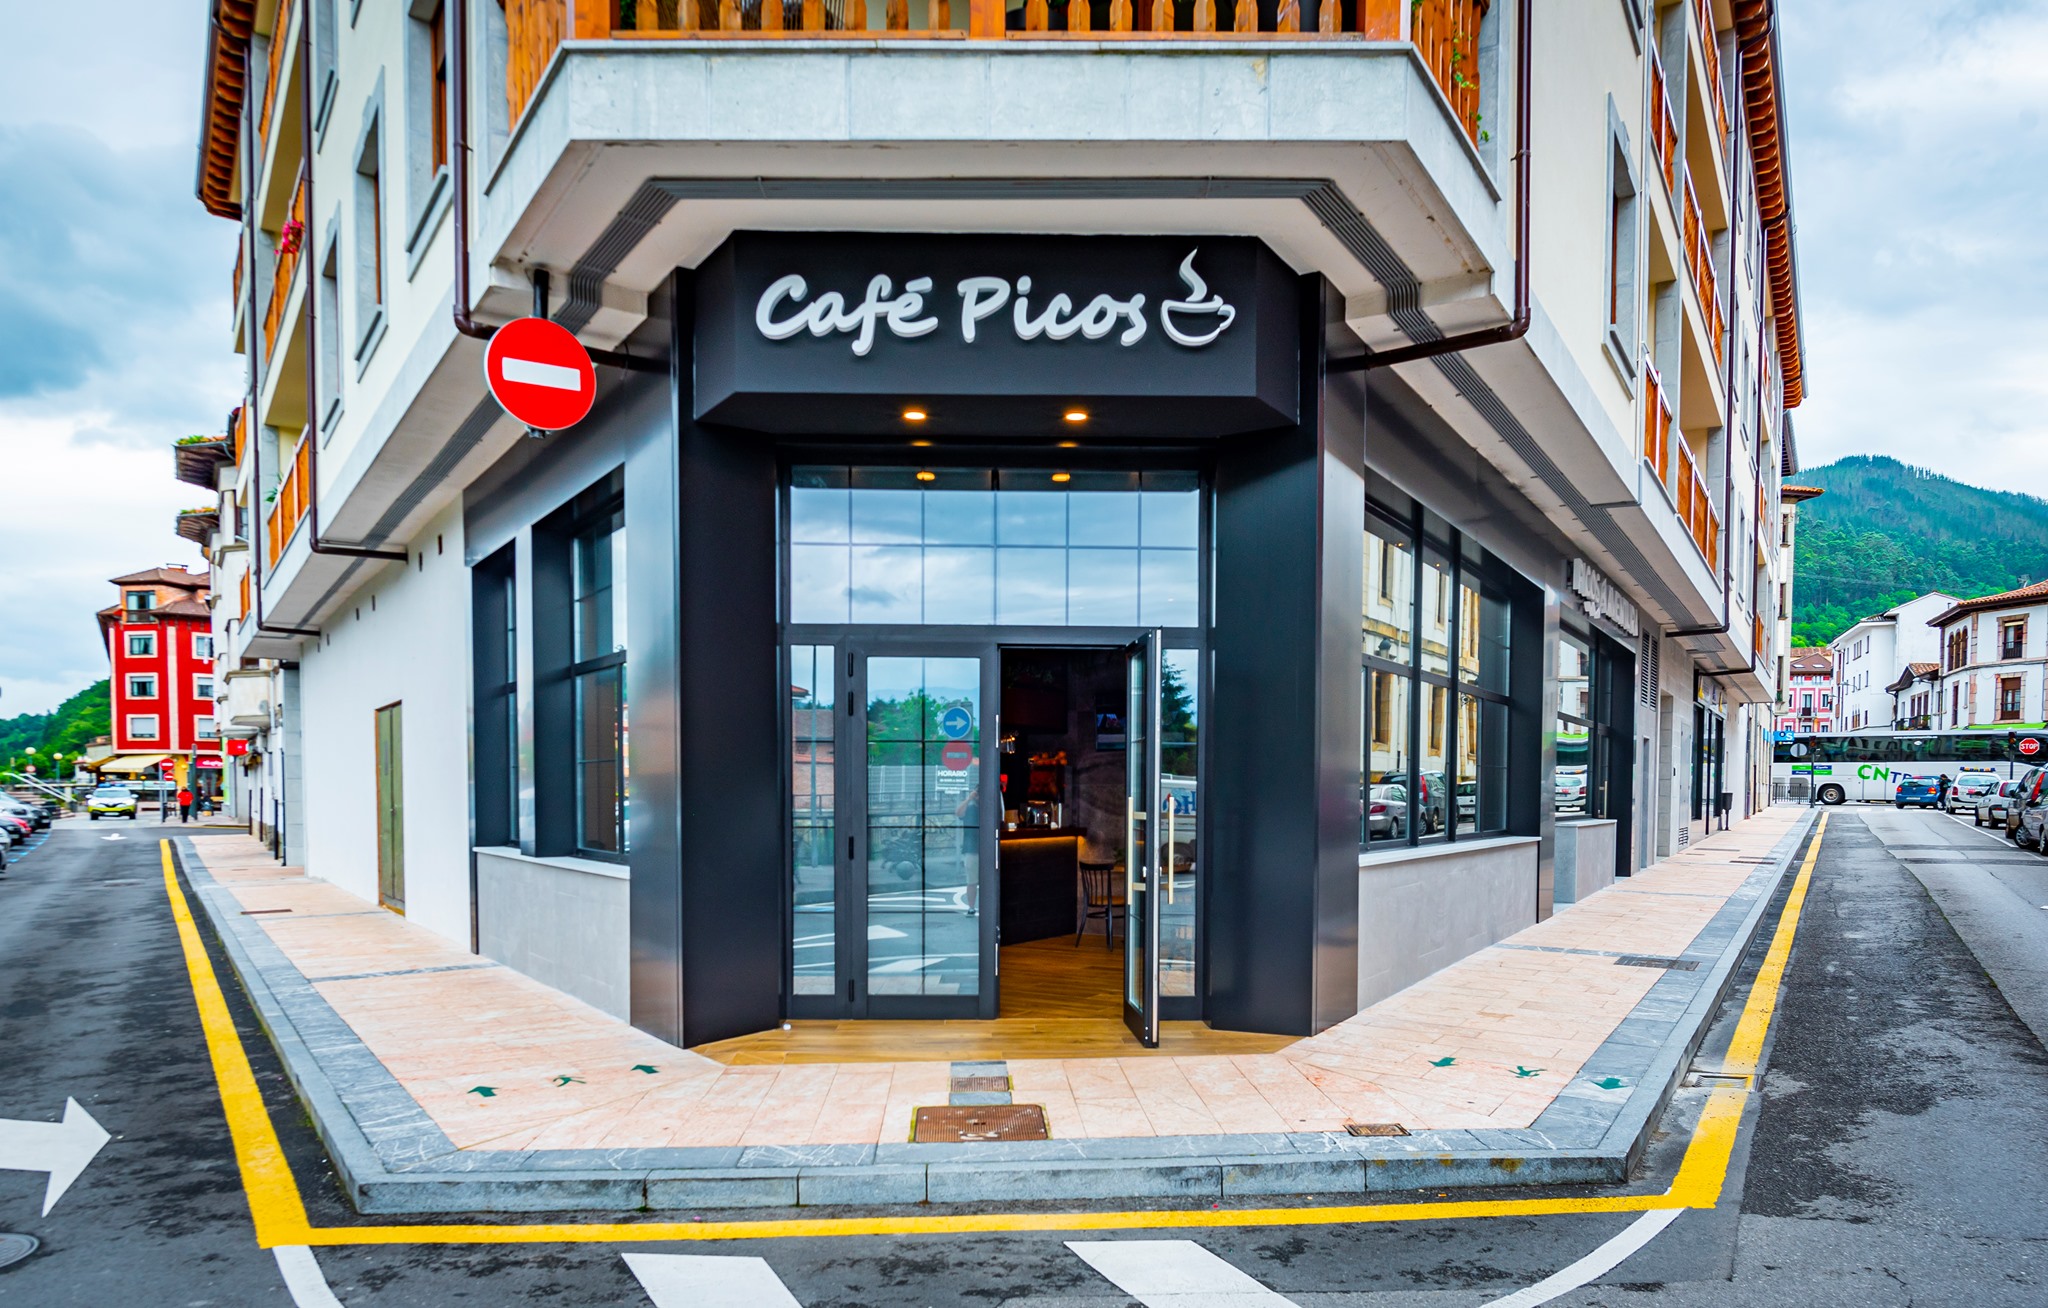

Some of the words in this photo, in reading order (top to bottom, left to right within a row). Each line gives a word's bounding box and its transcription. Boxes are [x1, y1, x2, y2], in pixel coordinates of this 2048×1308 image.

[755, 273, 939, 356] Café
[957, 275, 1147, 346] Picos
[937, 769, 968, 777] HORARIO
